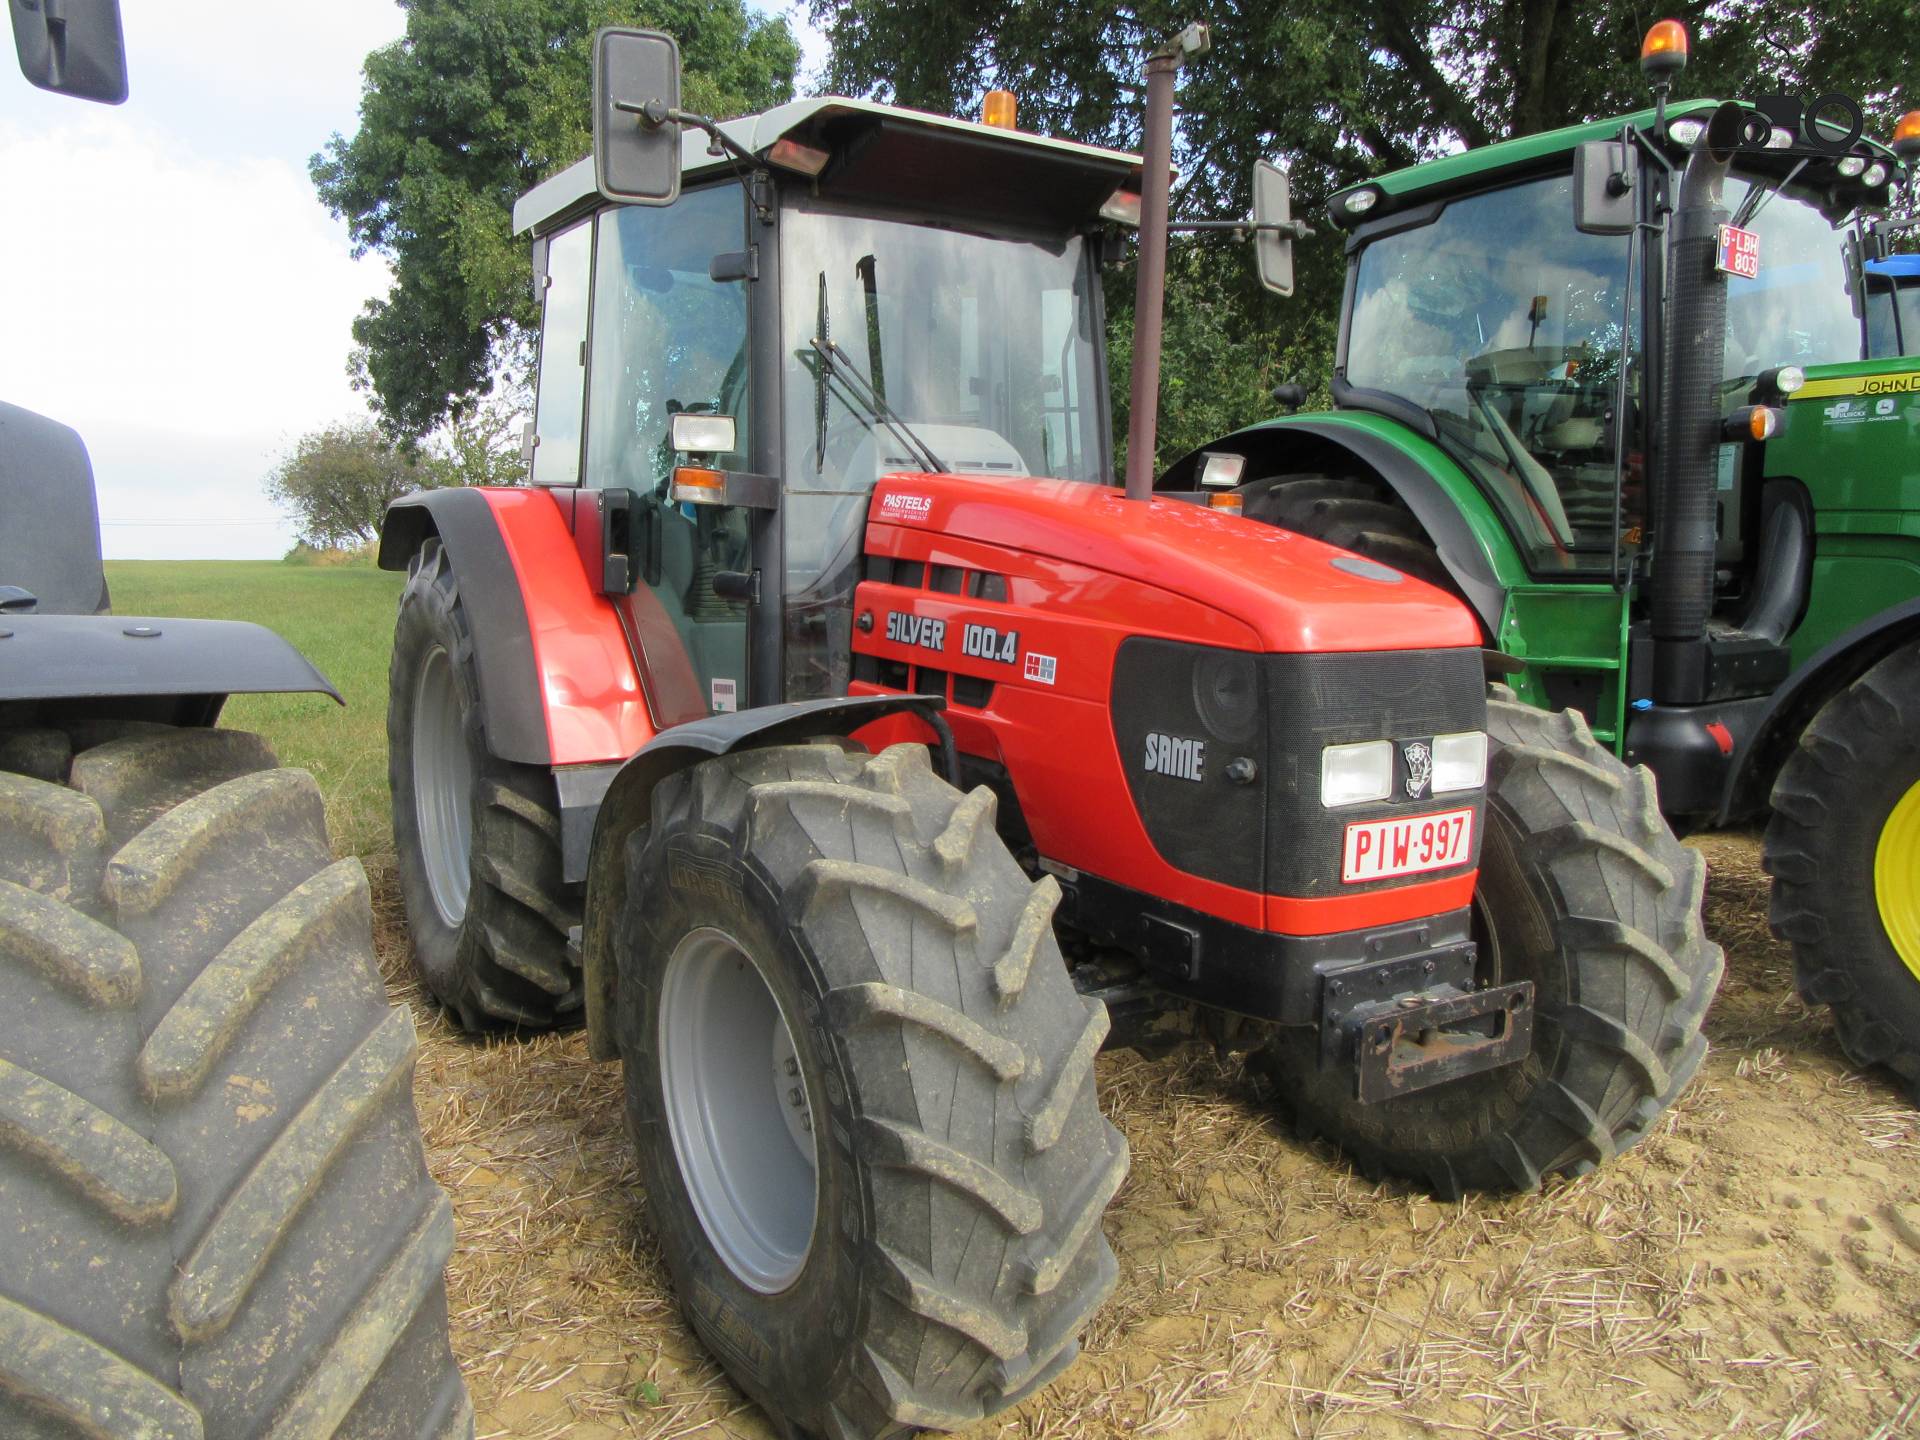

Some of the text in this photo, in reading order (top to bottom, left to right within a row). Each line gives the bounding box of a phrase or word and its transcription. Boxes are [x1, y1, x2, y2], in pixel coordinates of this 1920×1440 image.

[1723, 229, 1757, 256] G-LBH
[1735, 253, 1756, 273] 803
[1857, 379, 1907, 393] JOHN
[883, 494, 931, 511] PASTEELS
[886, 611, 1016, 663] SILVER 100.4
[1145, 733, 1203, 781] SAME
